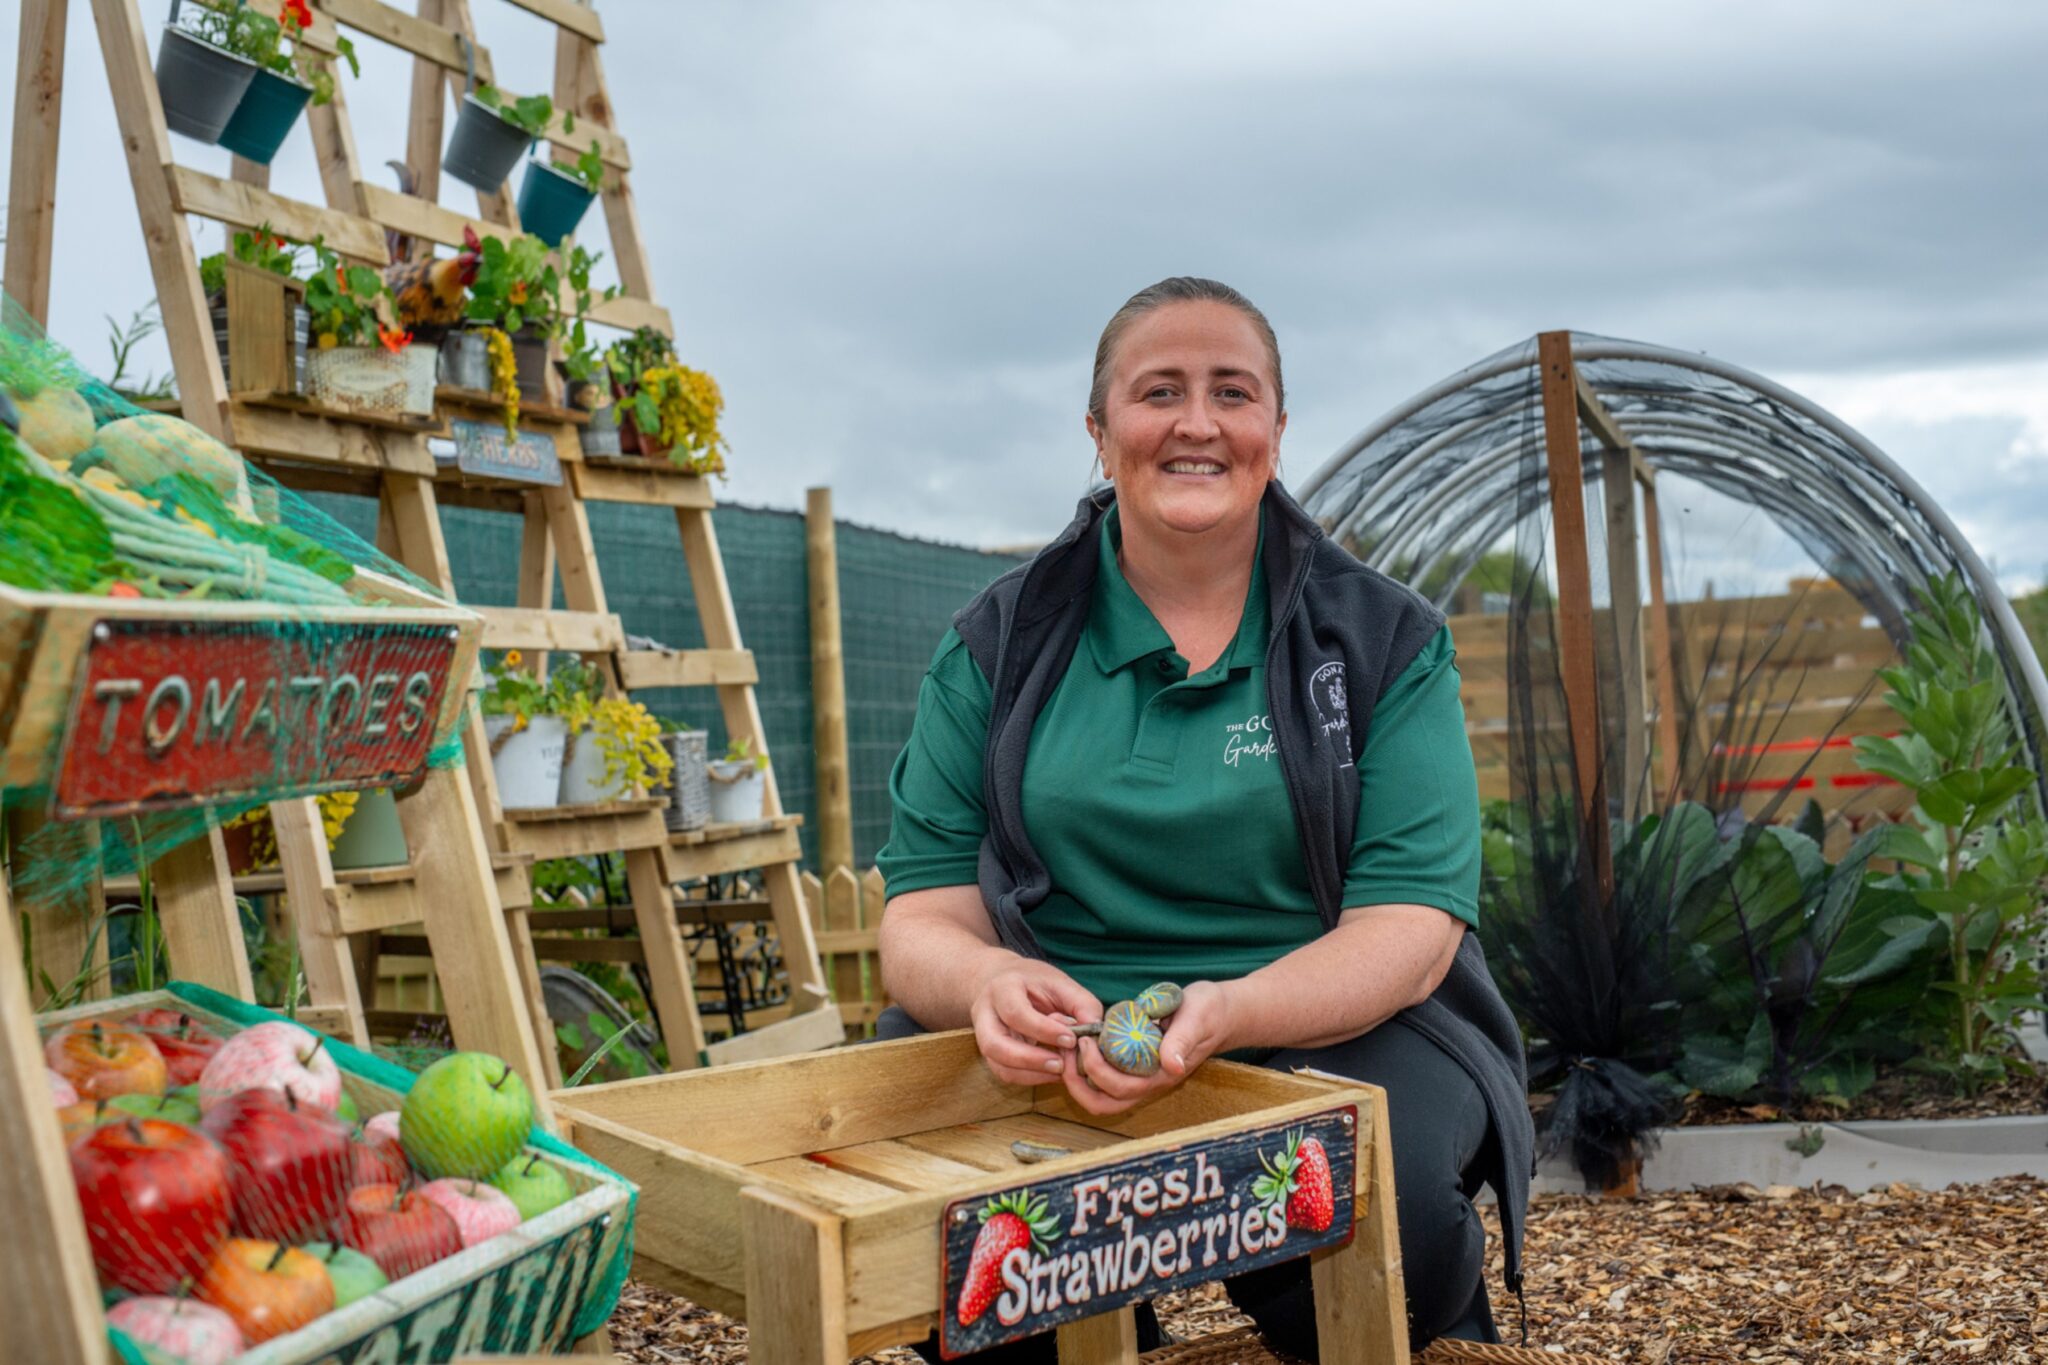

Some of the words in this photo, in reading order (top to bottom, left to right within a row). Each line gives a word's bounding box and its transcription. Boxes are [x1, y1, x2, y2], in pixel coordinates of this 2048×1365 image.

[93, 671, 432, 757] TOMATOES
[1226, 723, 1245, 732] THE
[1070, 1151, 1226, 1237] Fresh
[996, 1193, 1288, 1327] Strawberries
